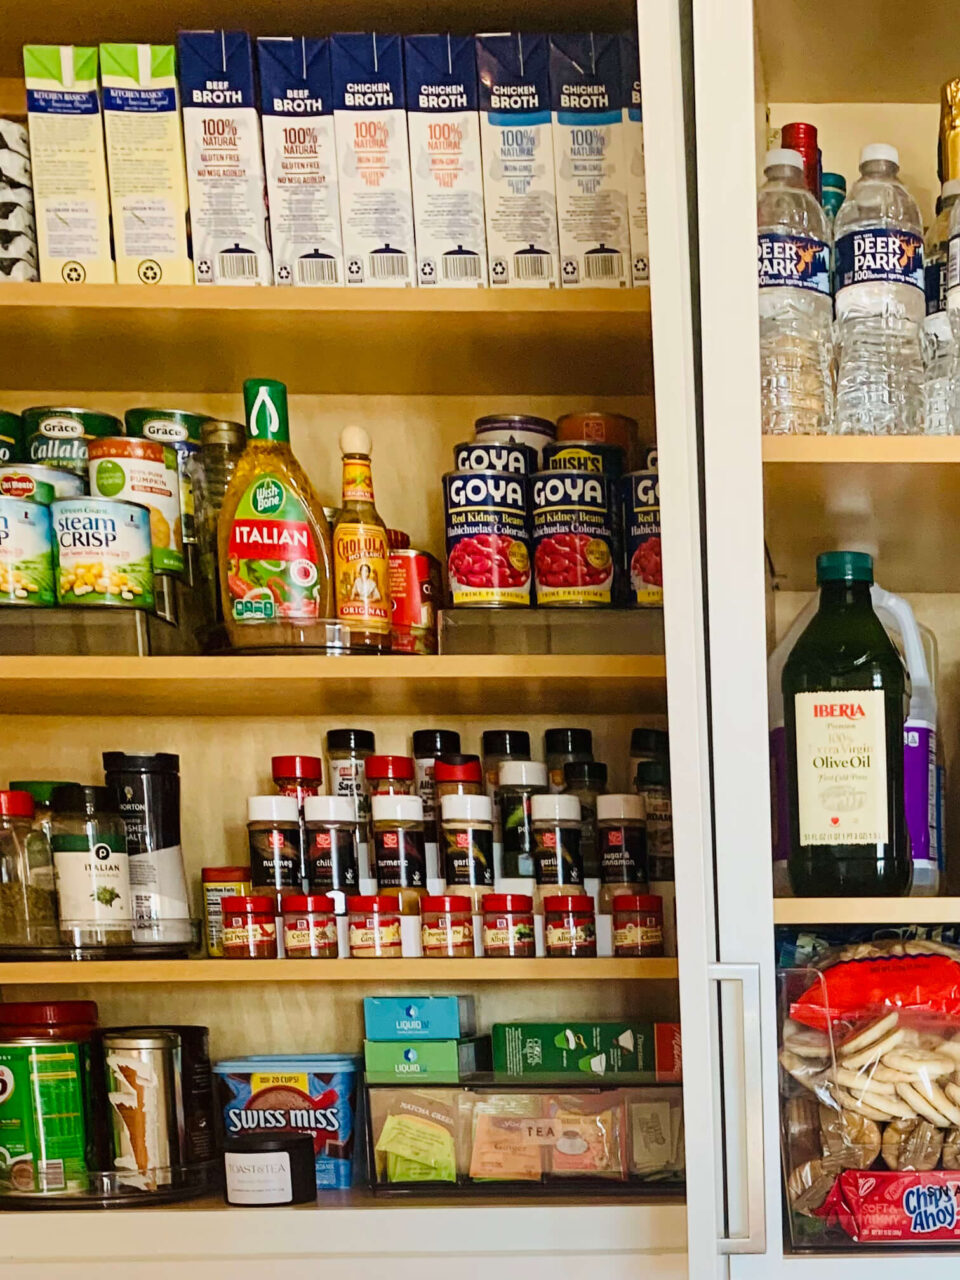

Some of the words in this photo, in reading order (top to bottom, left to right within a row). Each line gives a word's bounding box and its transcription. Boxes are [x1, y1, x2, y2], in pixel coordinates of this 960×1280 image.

[206, 81, 229, 90] BEEF
[346, 82, 390, 92] CHICKEN
[421, 84, 464, 94] CHICKEN
[493, 85, 536, 95] CHICKEN
[562, 85, 606, 94] CHICKEN
[192, 90, 243, 104] BROTH
[286, 89, 309, 98] BEEF
[344, 92, 394, 106] BROTH
[273, 98, 323, 112] BROTH
[419, 94, 467, 108] BROTH
[491, 95, 539, 109] BROTH
[560, 95, 609, 108] BROTH
[202, 119, 238, 136] 100%
[354, 121, 389, 139] 100%
[428, 123, 463, 140] 100%
[202, 137, 237, 147] NATURAL
[283, 128, 318, 144] 100%
[500, 129, 535, 146] 100%
[570, 129, 605, 146] 100%
[283, 145, 318, 154] NATURAL
[854, 237, 900, 256] DEER
[854, 253, 901, 271] PARK
[44, 422, 78, 433] Grace
[148, 425, 182, 437] Grace
[457, 449, 525, 474] GOYA
[130, 476, 168, 488] PUMPKIN
[450, 479, 523, 507] GOYA
[533, 479, 602, 506] GOYA
[257, 495, 280, 510] Bone
[59, 516, 117, 532] steam
[452, 515, 466, 525] Red
[467, 512, 499, 525] Kidney
[547, 512, 577, 526] Kidney
[579, 513, 604, 525] Beans
[60, 532, 117, 547] CRISP
[235, 526, 308, 547] ITALIAN
[813, 704, 866, 720] IBERIA
[812, 755, 849, 769] Olive
[849, 755, 871, 768] Oil
[272, 1076, 280, 1084] 20
[281, 1076, 300, 1084] CUPS!
[527, 1126, 555, 1138] TEA
